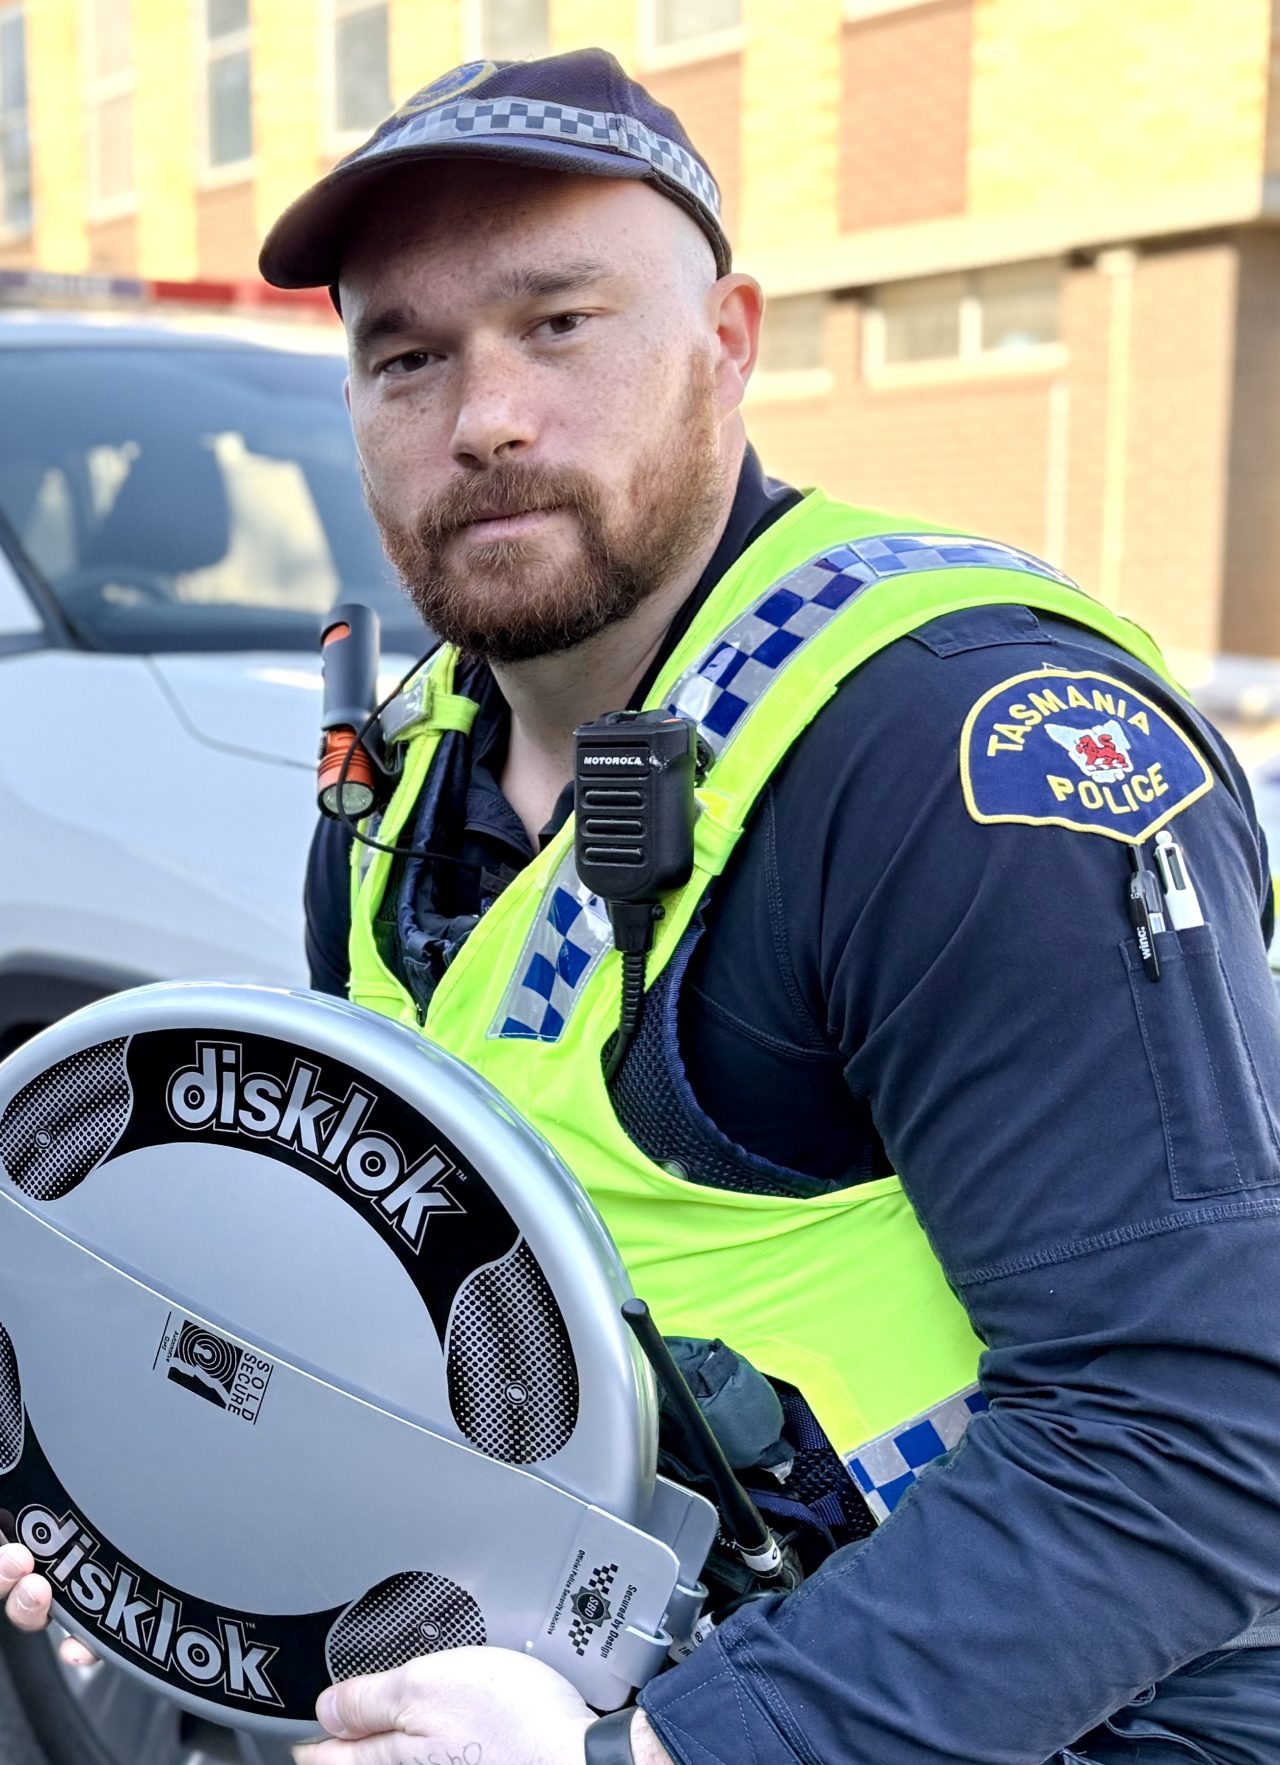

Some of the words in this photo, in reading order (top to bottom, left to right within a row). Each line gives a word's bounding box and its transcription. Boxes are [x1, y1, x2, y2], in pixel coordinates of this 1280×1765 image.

[987, 686, 1150, 757] TASMANIA
[584, 757, 642, 765] MOTOROLA
[1046, 762, 1169, 815] POLICE
[166, 1040, 468, 1255] disklok
[227, 1352, 257, 1416] SECURE
[241, 1360, 270, 1421] SOLD
[574, 1549, 586, 1572] Official
[565, 1570, 578, 1589] Police
[16, 1504, 286, 1707] disklok
[555, 1587, 571, 1611] Security
[584, 1596, 599, 1618] SBD
[616, 1584, 638, 1620] Secured
[610, 1619, 624, 1631] by
[600, 1629, 619, 1659] Design
